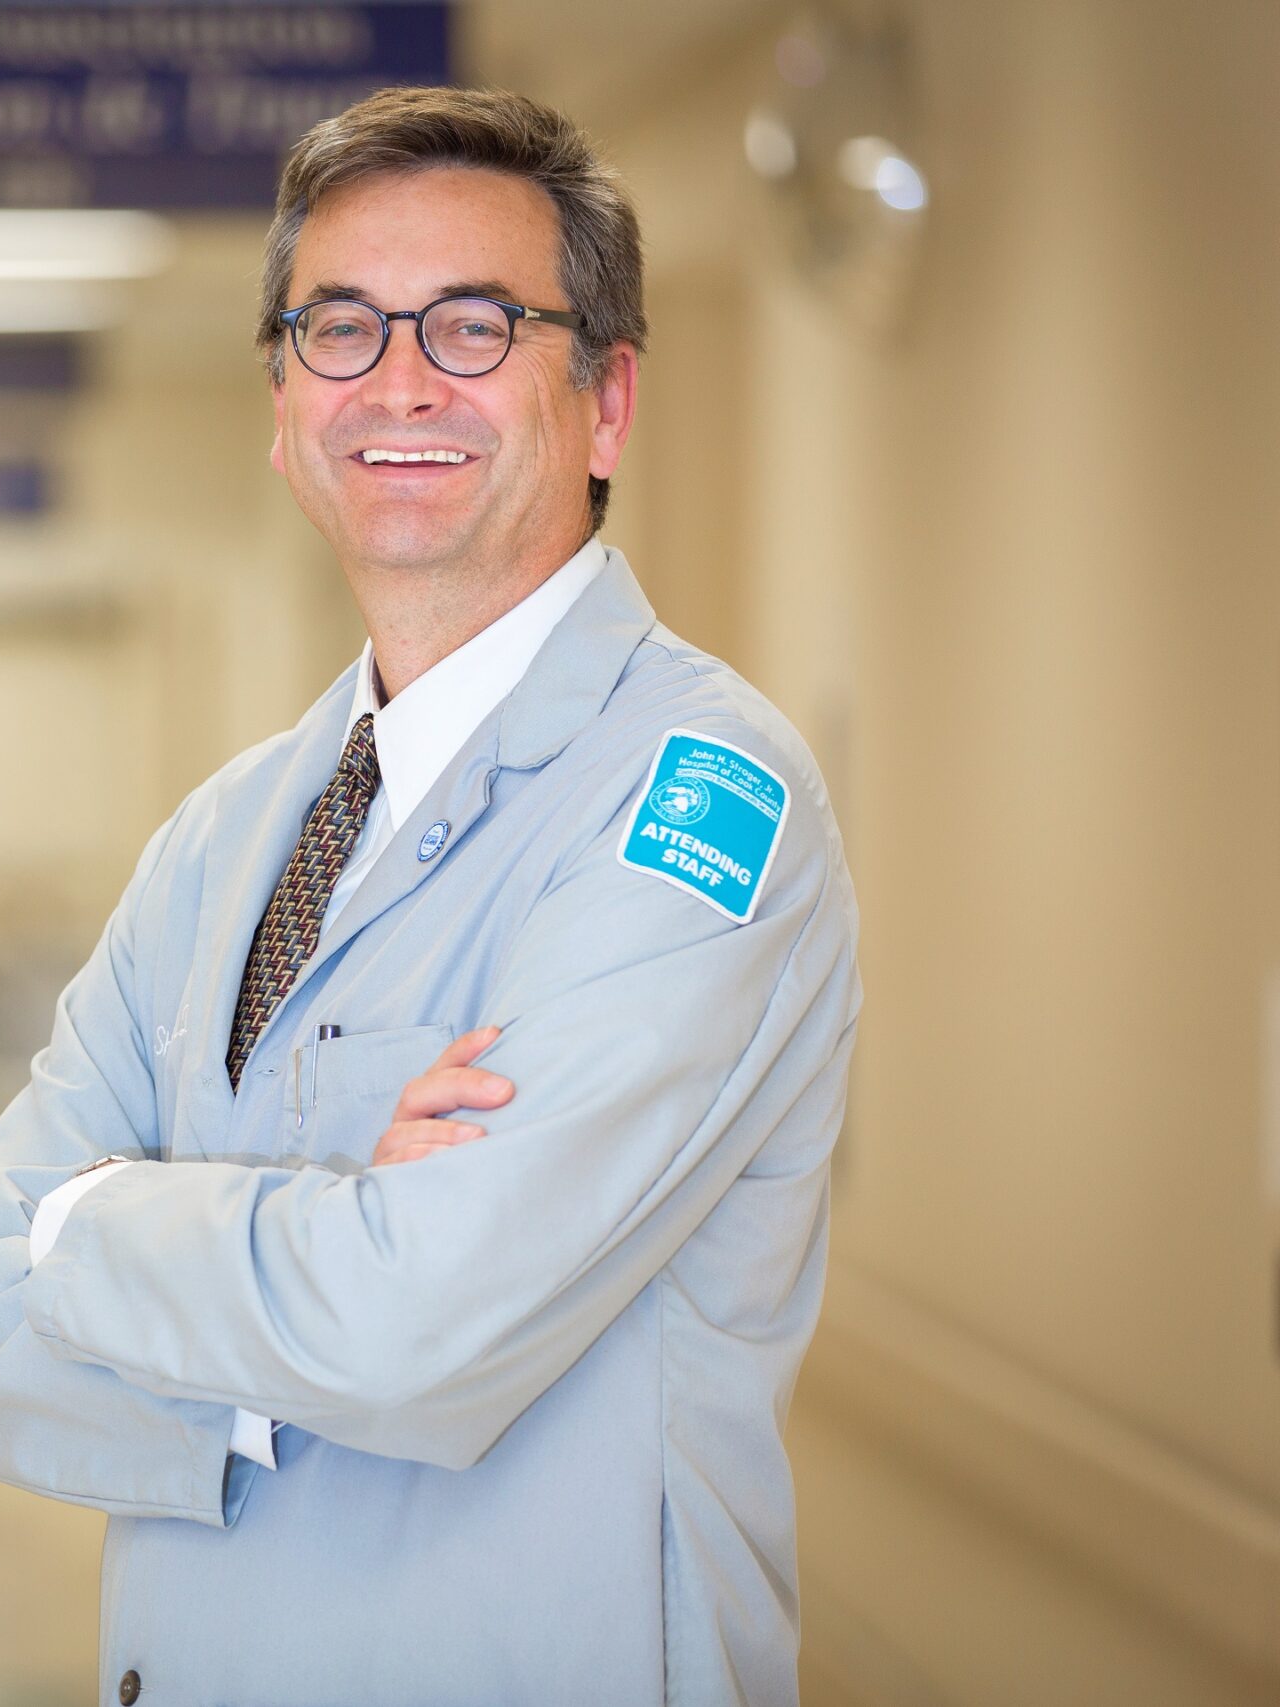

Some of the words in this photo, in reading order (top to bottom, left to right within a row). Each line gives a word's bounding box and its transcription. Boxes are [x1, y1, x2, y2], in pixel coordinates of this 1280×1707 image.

[689, 748, 715, 761] John
[716, 754, 727, 766] H.
[678, 756, 719, 771] Hospital
[720, 768, 732, 778] of
[732, 773, 754, 791] Cook
[754, 787, 781, 813] County
[640, 822, 753, 886] ATTENDING
[661, 849, 724, 887] STAFF
